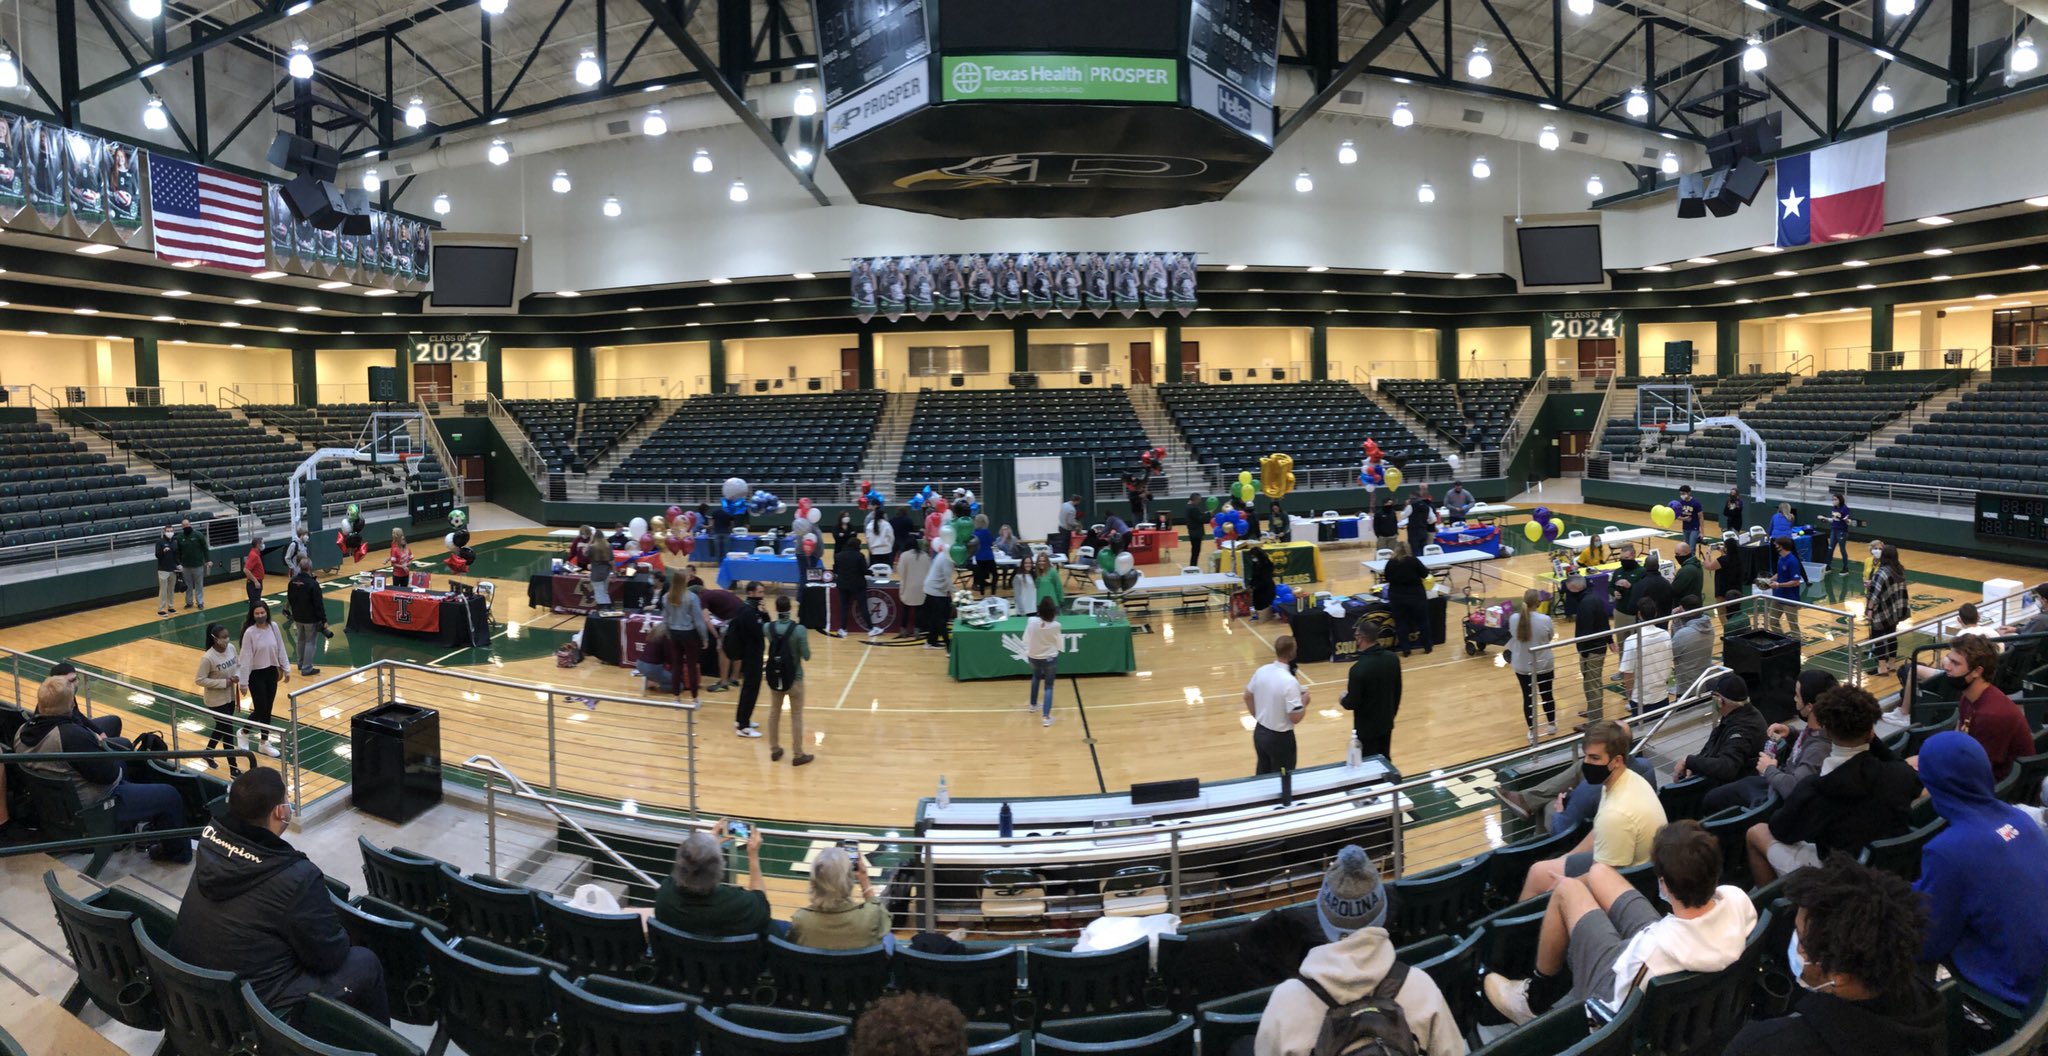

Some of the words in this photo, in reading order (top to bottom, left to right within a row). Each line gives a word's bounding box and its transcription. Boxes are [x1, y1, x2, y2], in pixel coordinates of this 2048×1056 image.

[983, 66, 1028, 81] Texas
[1031, 66, 1082, 82] Health
[1090, 67, 1168, 84] PROSPER
[863, 78, 921, 118] PROSPER
[1551, 318, 1616, 338] 2024
[457, 334, 467, 342] OF
[416, 343, 481, 362] 2023
[216, 655, 237, 671] TOMM
[202, 825, 262, 864] Champion
[1323, 890, 1379, 917] AROLINA
